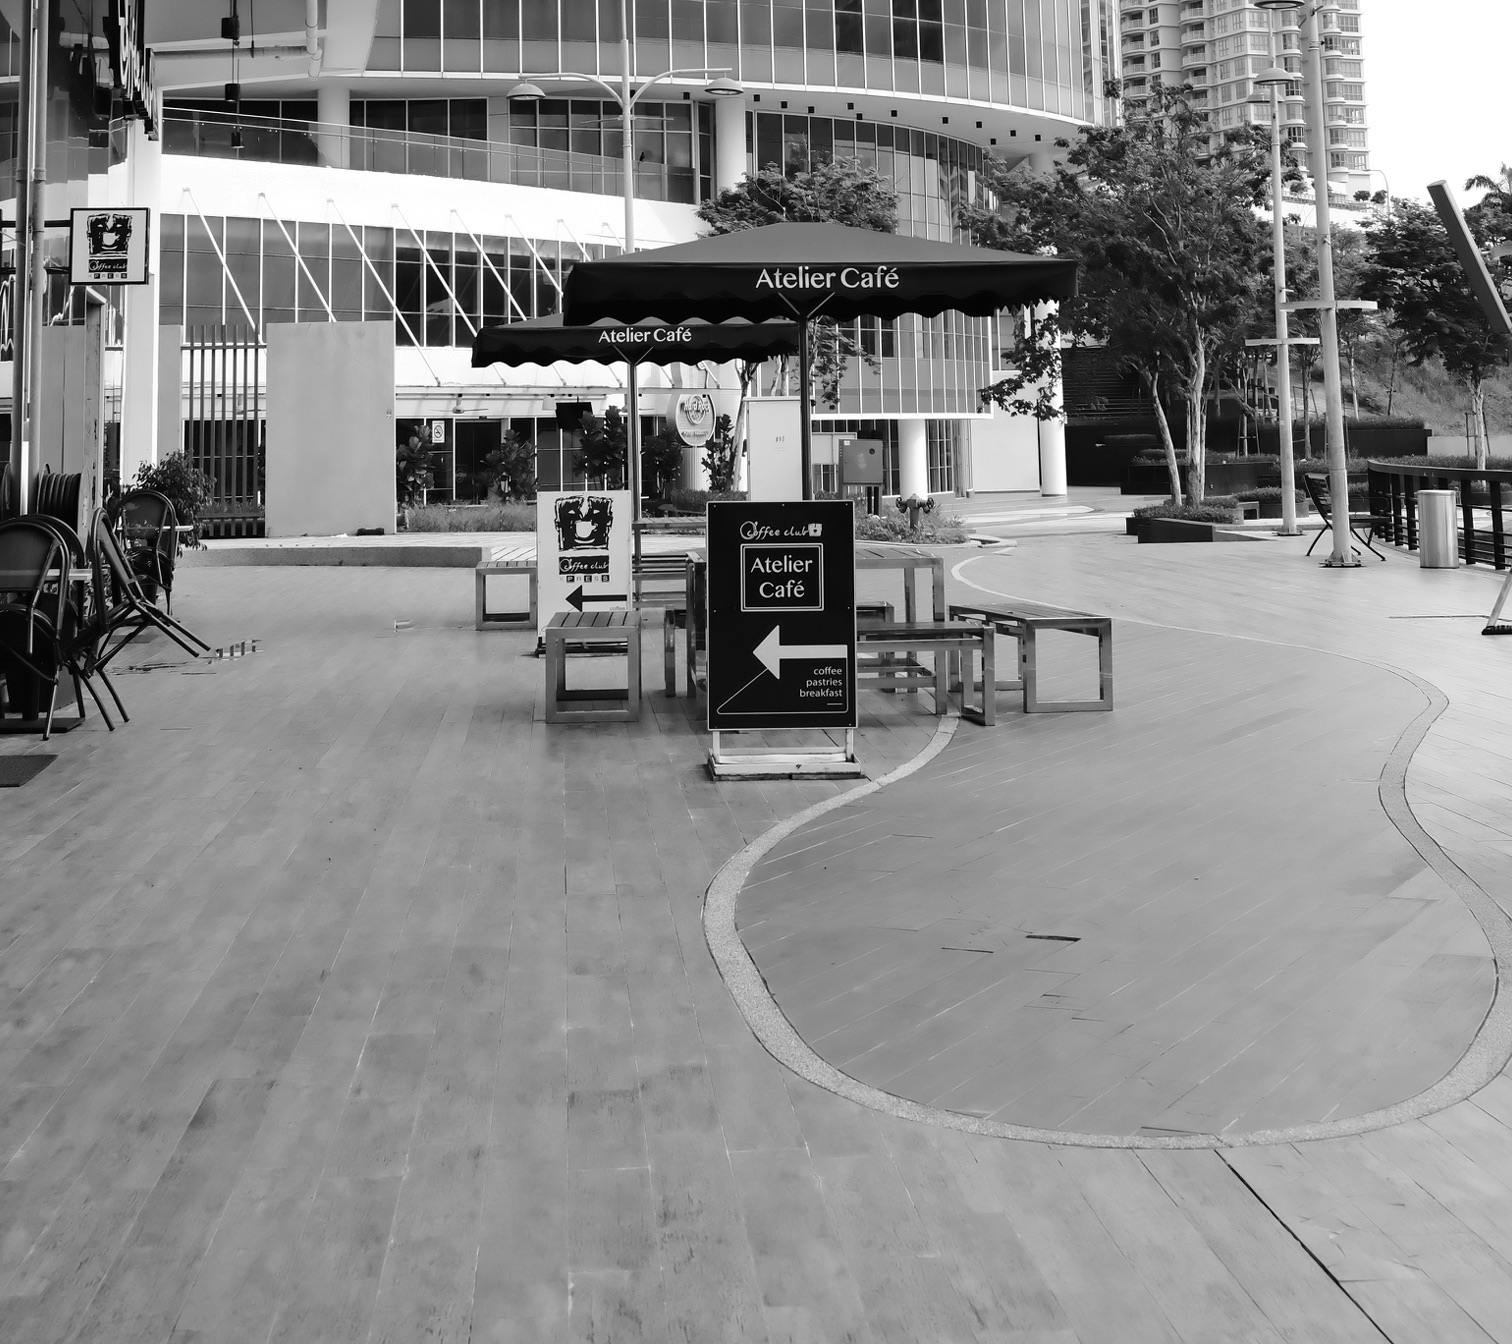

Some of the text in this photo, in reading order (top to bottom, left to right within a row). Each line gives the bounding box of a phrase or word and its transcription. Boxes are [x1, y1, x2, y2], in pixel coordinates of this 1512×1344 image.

[755, 265, 899, 289] Atelier Café
[598, 326, 692, 344] Atelier Café
[784, 526, 808, 536] club
[590, 561, 609, 570] club
[750, 554, 813, 573] Atelier
[759, 579, 805, 598] Café
[813, 666, 842, 675] coffee
[806, 677, 843, 688] pastries
[799, 688, 842, 698] breakfast
